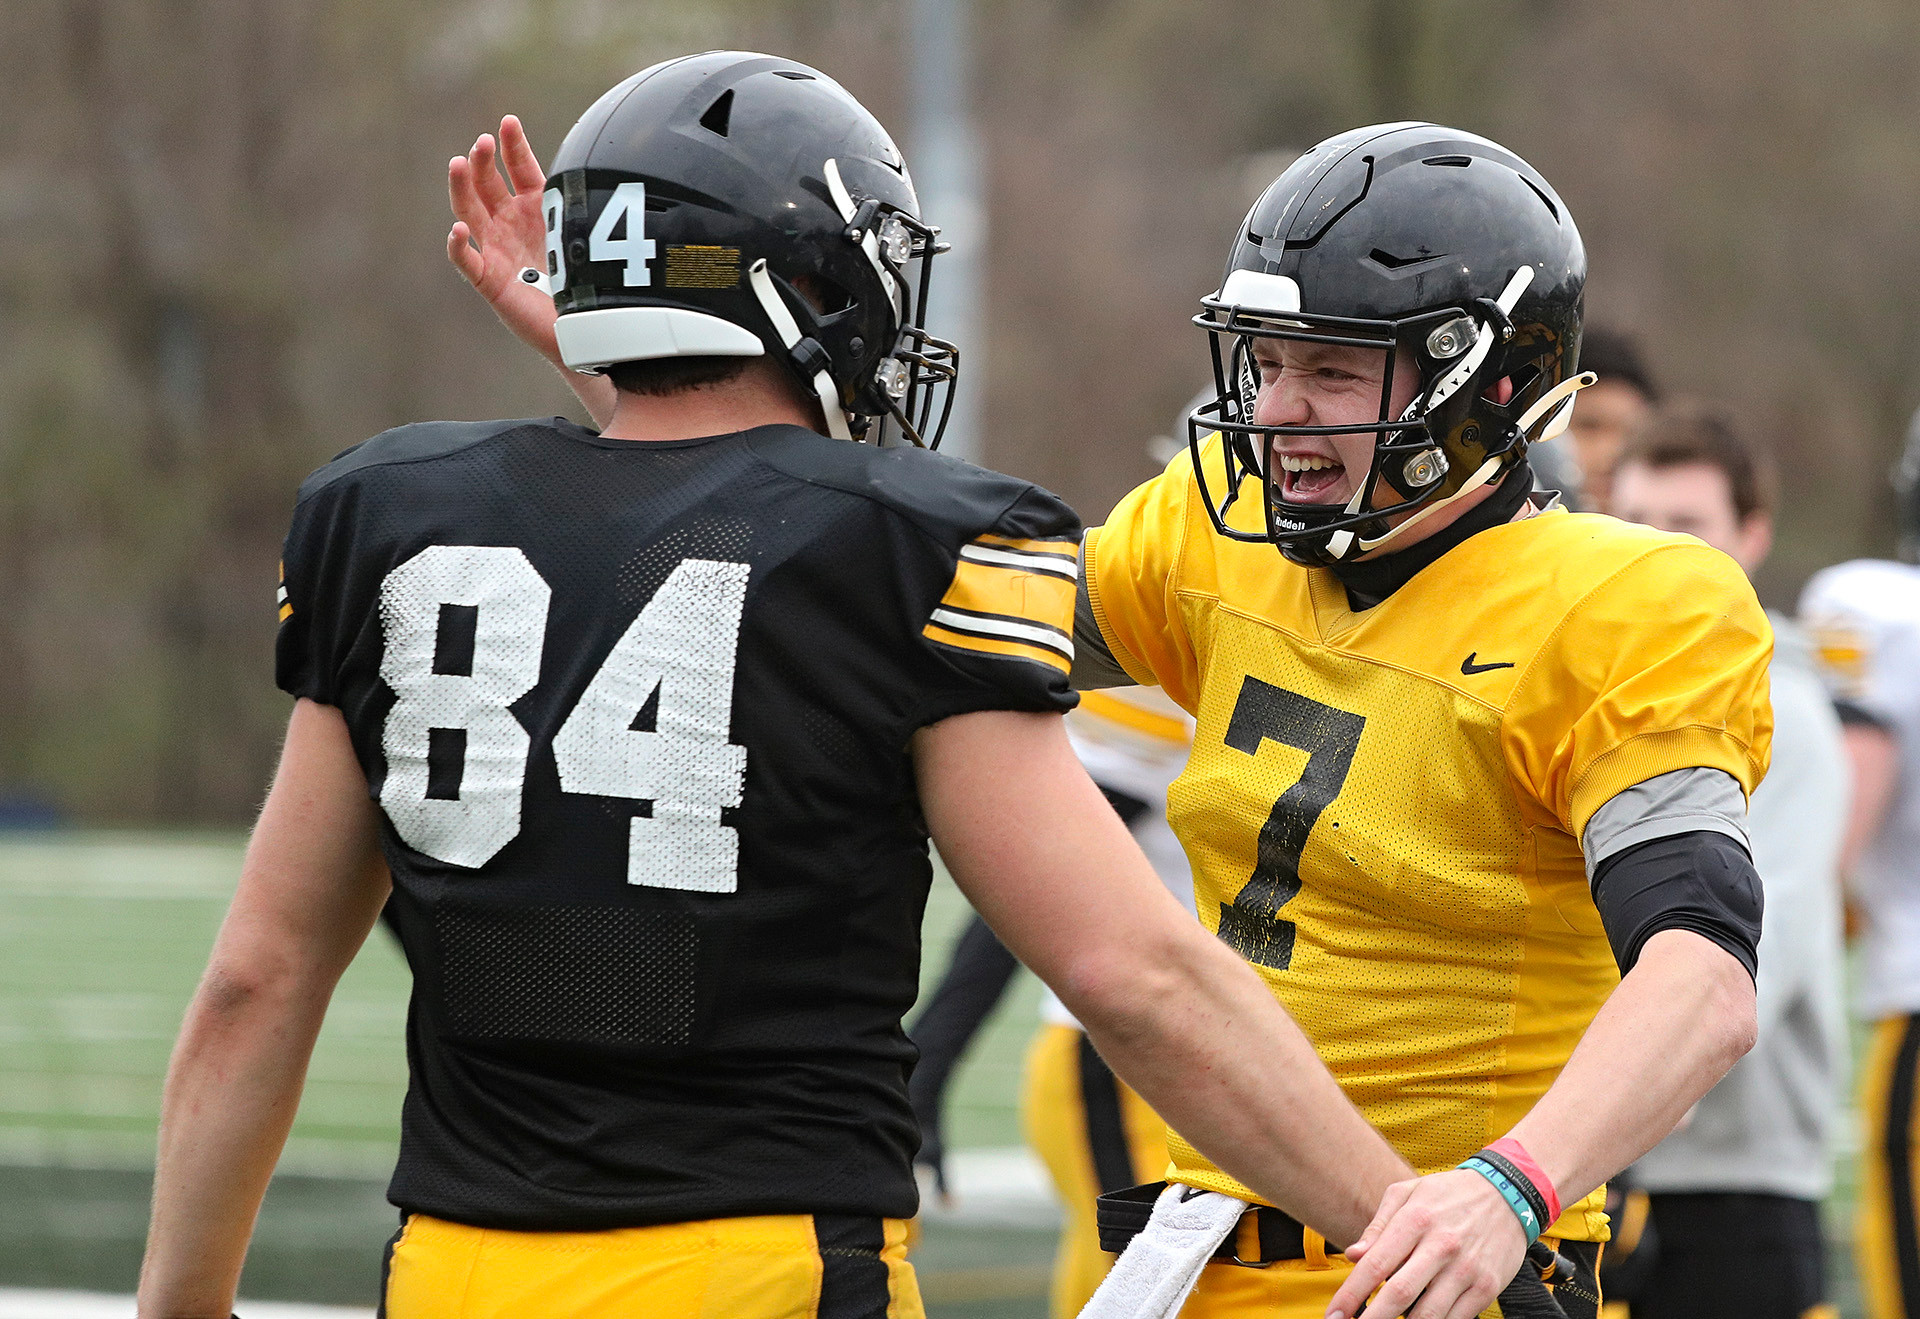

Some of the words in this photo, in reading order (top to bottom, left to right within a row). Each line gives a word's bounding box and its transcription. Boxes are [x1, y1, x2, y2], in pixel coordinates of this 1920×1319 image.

[1275, 516, 1305, 530] Riddell
[379, 545, 752, 894] 84
[1217, 674, 1367, 971] 7
